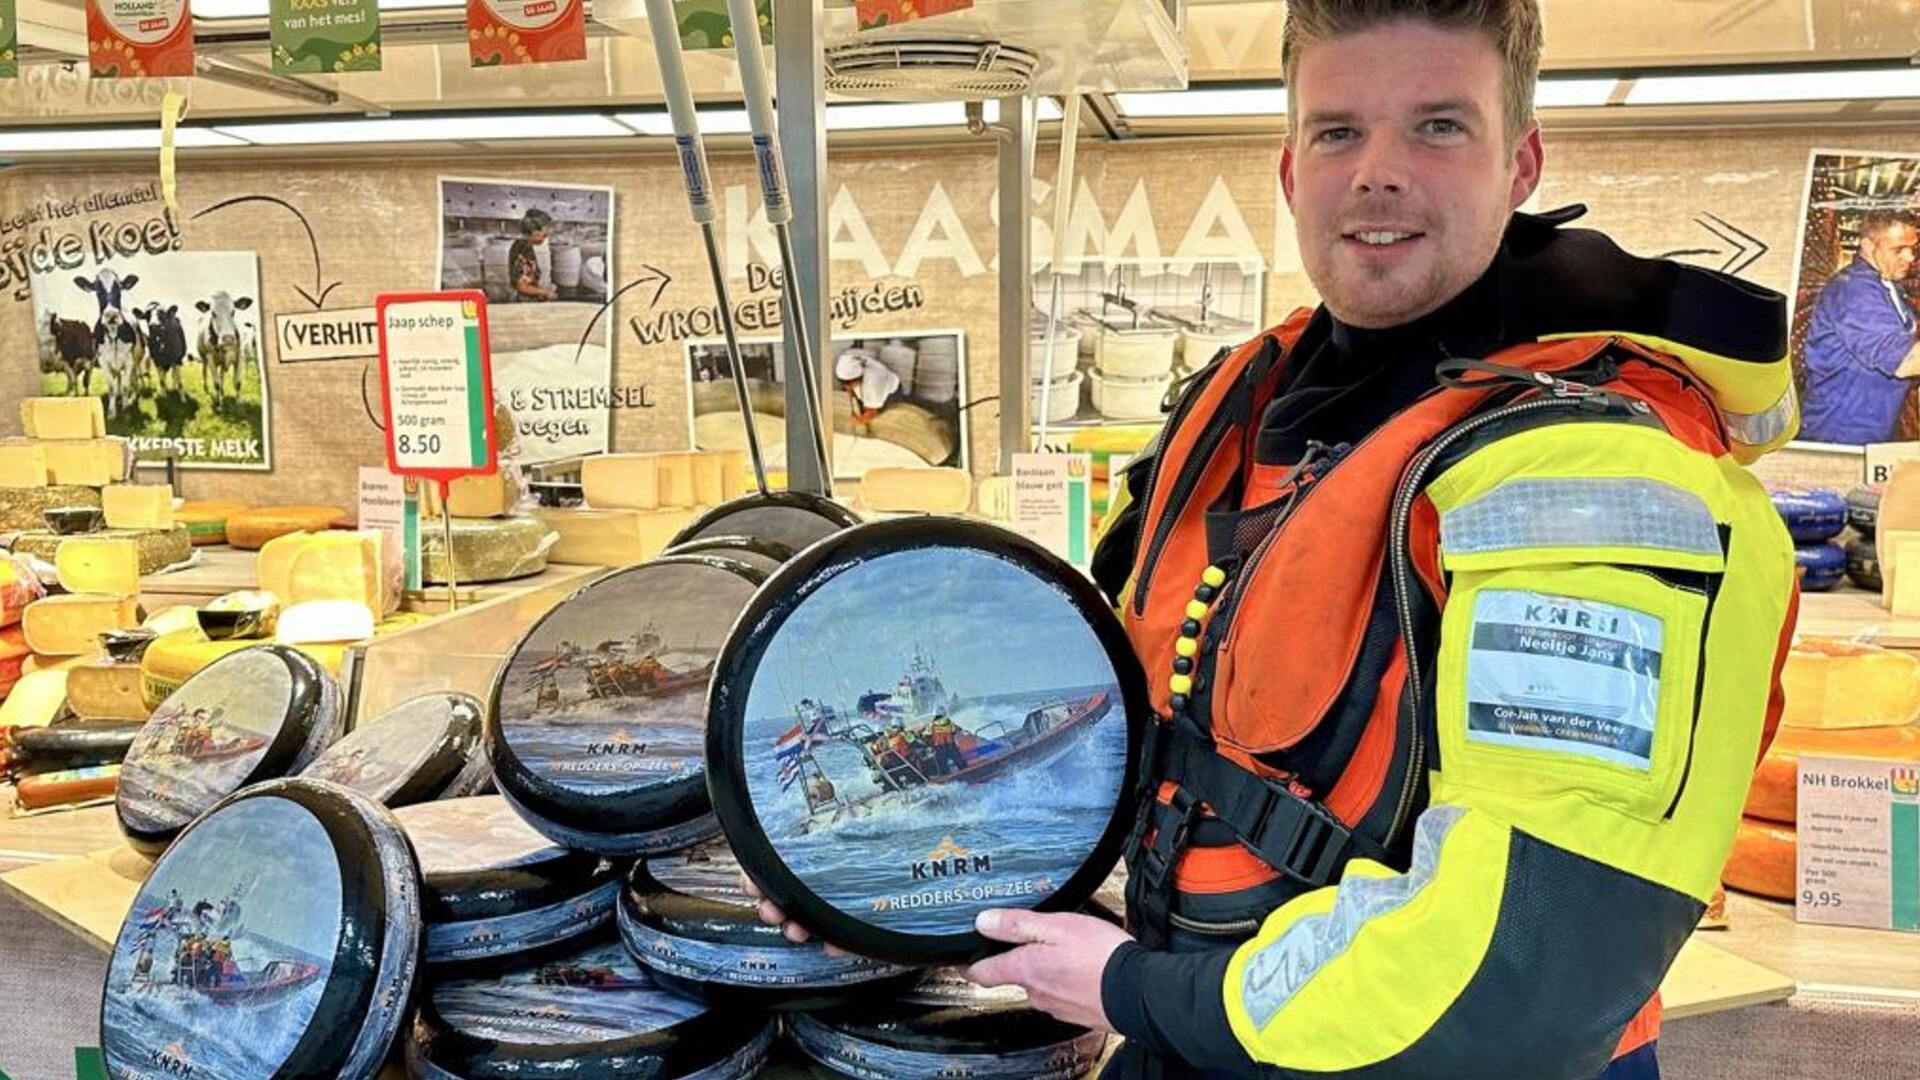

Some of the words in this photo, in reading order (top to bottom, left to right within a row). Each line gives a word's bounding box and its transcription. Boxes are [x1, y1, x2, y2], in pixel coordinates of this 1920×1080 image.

[284, 18, 307, 29] van
[309, 14, 332, 27] het
[334, 9, 366, 25] mes!
[29, 227, 85, 275] de
[89, 206, 183, 265] koe!
[746, 263, 784, 293] De
[388, 315, 416, 332] Jaap
[418, 313, 454, 330] schep
[630, 298, 784, 346] WROGE
[830, 284, 924, 328] nijden
[531, 384, 656, 412] STREMSEL
[398, 415, 418, 426] 500
[420, 416, 446, 428] gram
[519, 418, 592, 444] oegen
[210, 437, 259, 459] MELK
[398, 433, 441, 455] 8.50
[1519, 634, 1577, 656] Neeltje
[1579, 644, 1615, 663] Jans
[1493, 706, 1539, 723] Cor-Jan
[1541, 714, 1566, 725] van
[1569, 715, 1593, 729] der
[1596, 719, 1626, 736] Veer
[586, 743, 647, 755] KNRM
[1803, 773, 1826, 787] NH
[1830, 775, 1889, 790] Brokkel
[911, 855, 992, 880] KNRM
[889, 888, 963, 911] REDDERS
[1803, 890, 1842, 908] 9,95
[149, 1048, 194, 1079] KNRM
